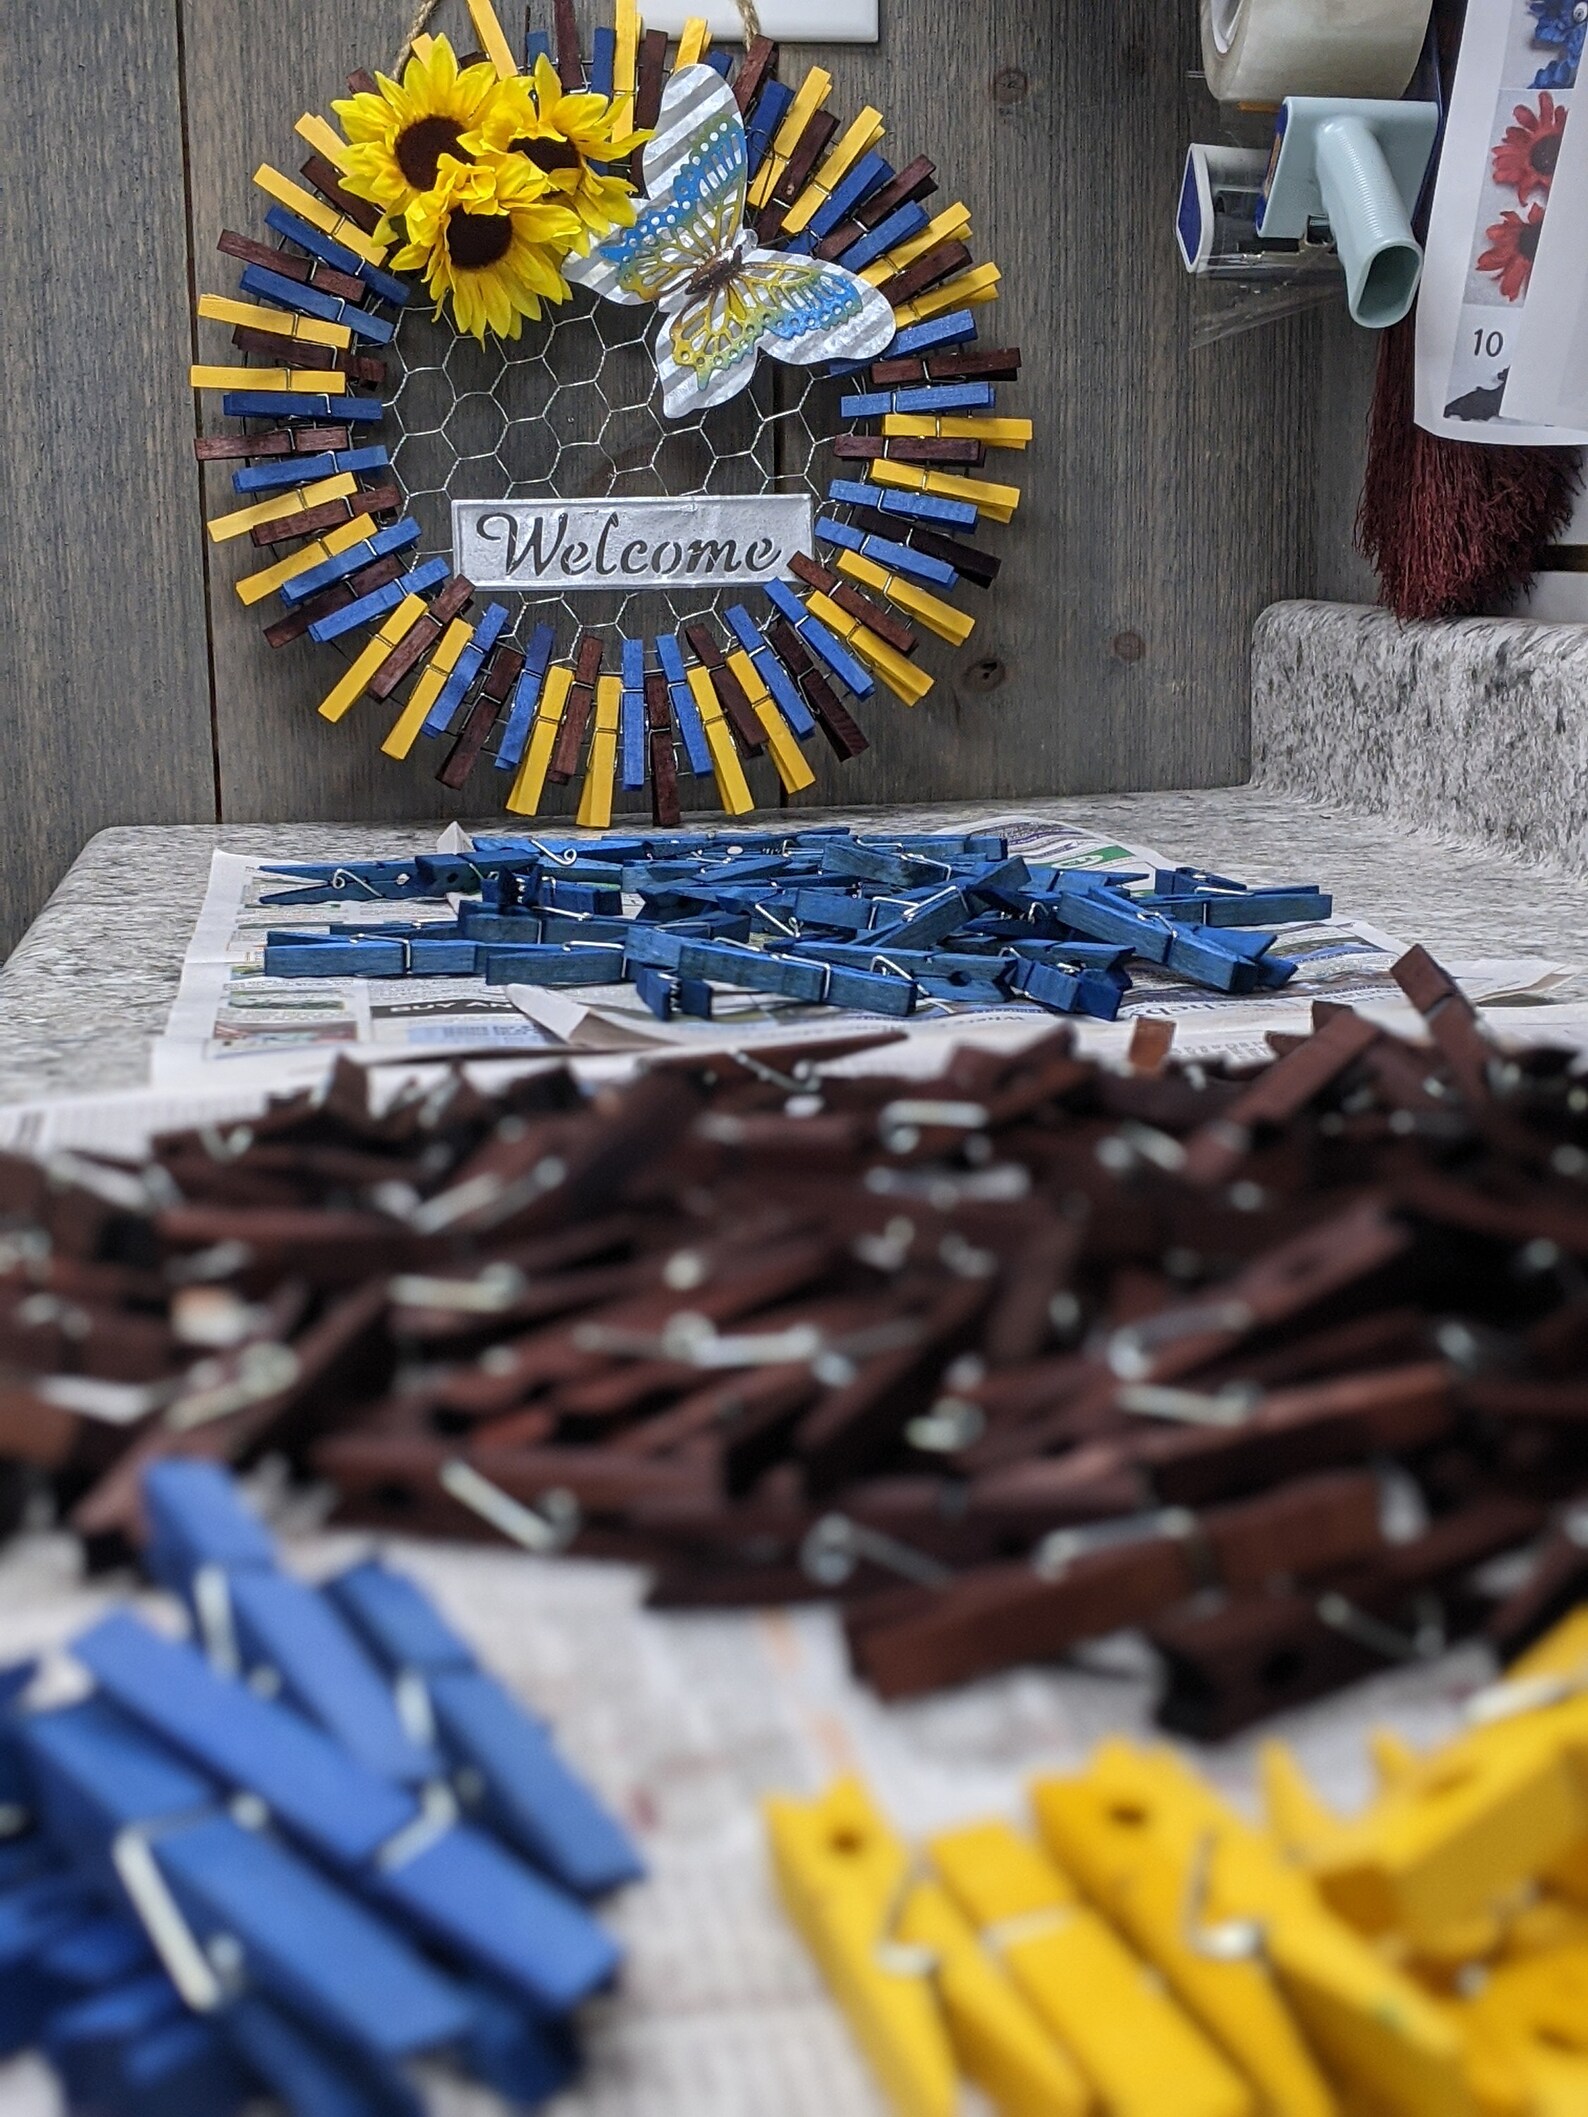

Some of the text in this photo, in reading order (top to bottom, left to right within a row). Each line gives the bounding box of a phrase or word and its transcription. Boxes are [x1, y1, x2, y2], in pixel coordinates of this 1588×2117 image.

[1474, 328, 1504, 357] 10
[476, 511, 782, 577] Welcome
[390, 1002, 457, 1012] BUY
